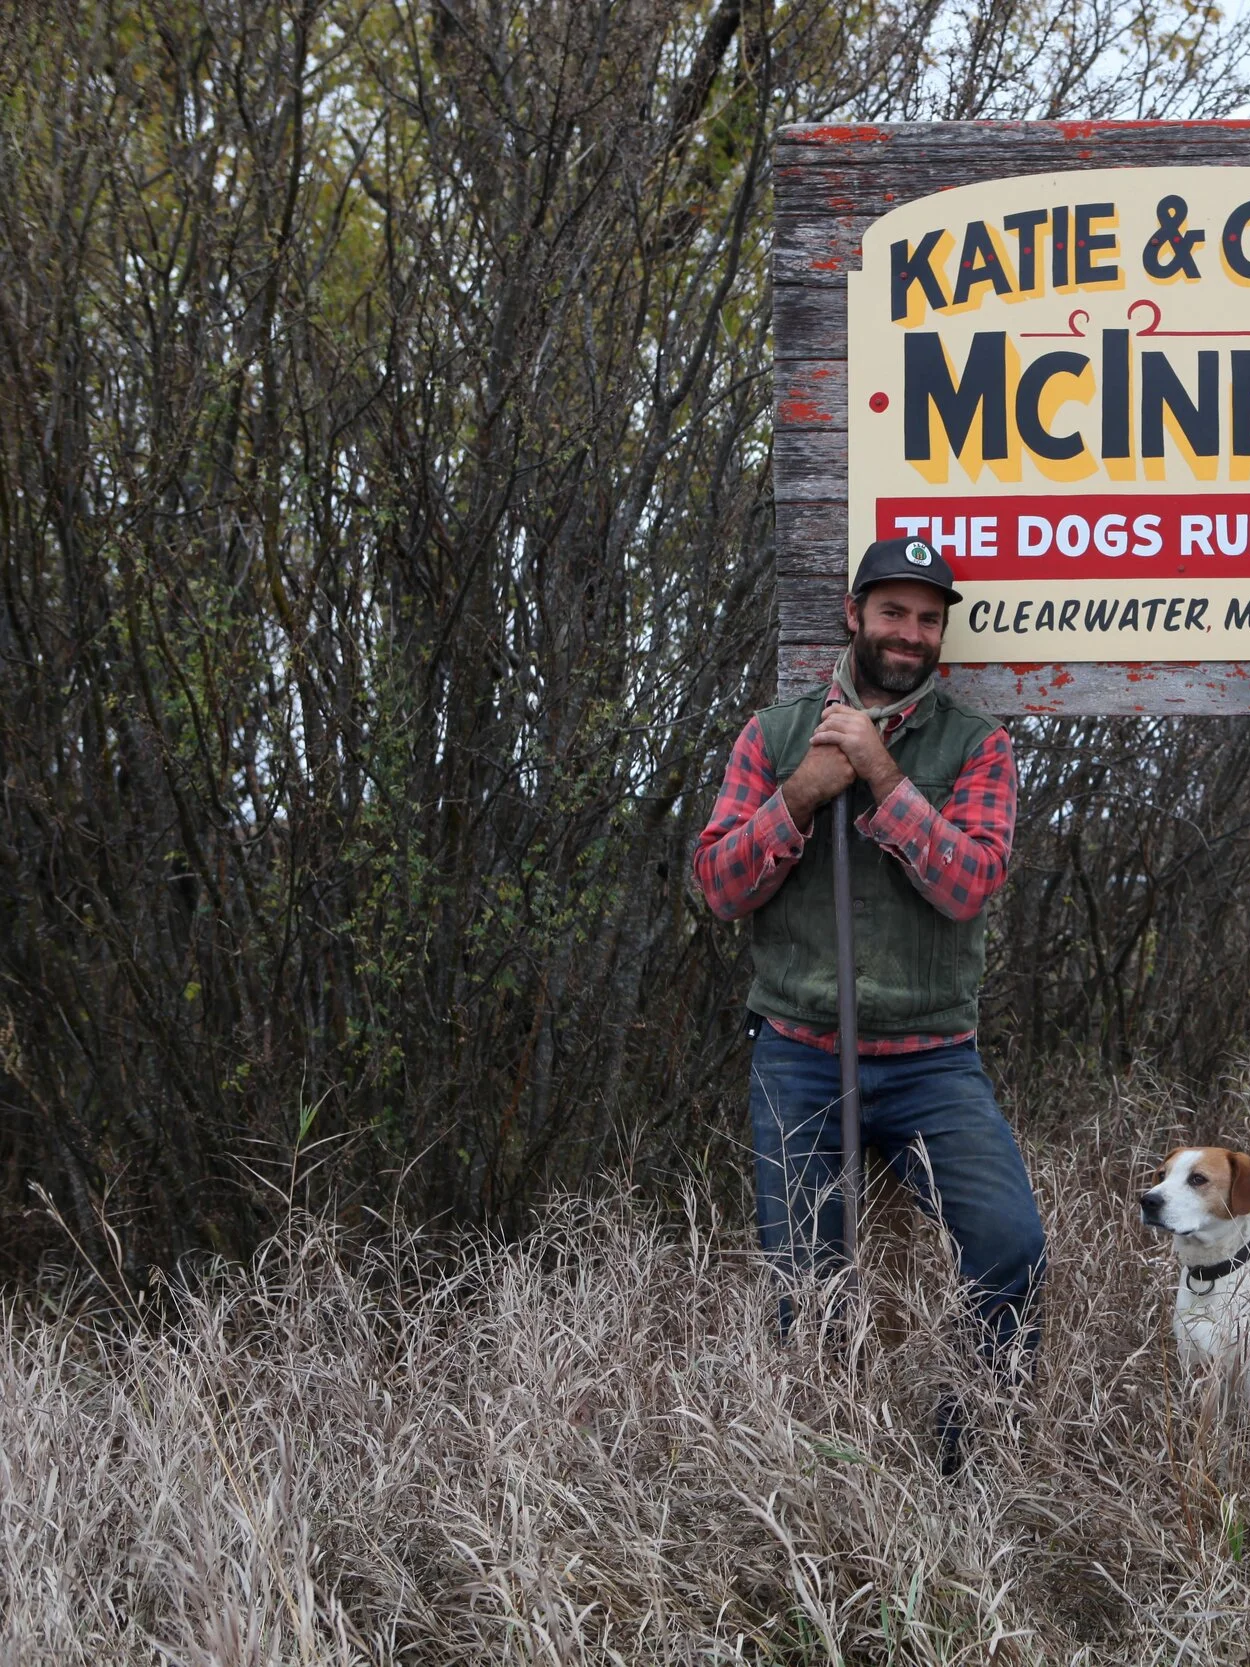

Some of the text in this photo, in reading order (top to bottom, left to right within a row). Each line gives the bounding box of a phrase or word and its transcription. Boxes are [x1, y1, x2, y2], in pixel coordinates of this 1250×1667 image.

[889, 203, 1119, 323] KATIE
[1143, 194, 1206, 280] &
[894, 516, 998, 557] THE
[1017, 513, 1163, 557] DOGS
[968, 597, 1212, 633] CLEARWATER,
